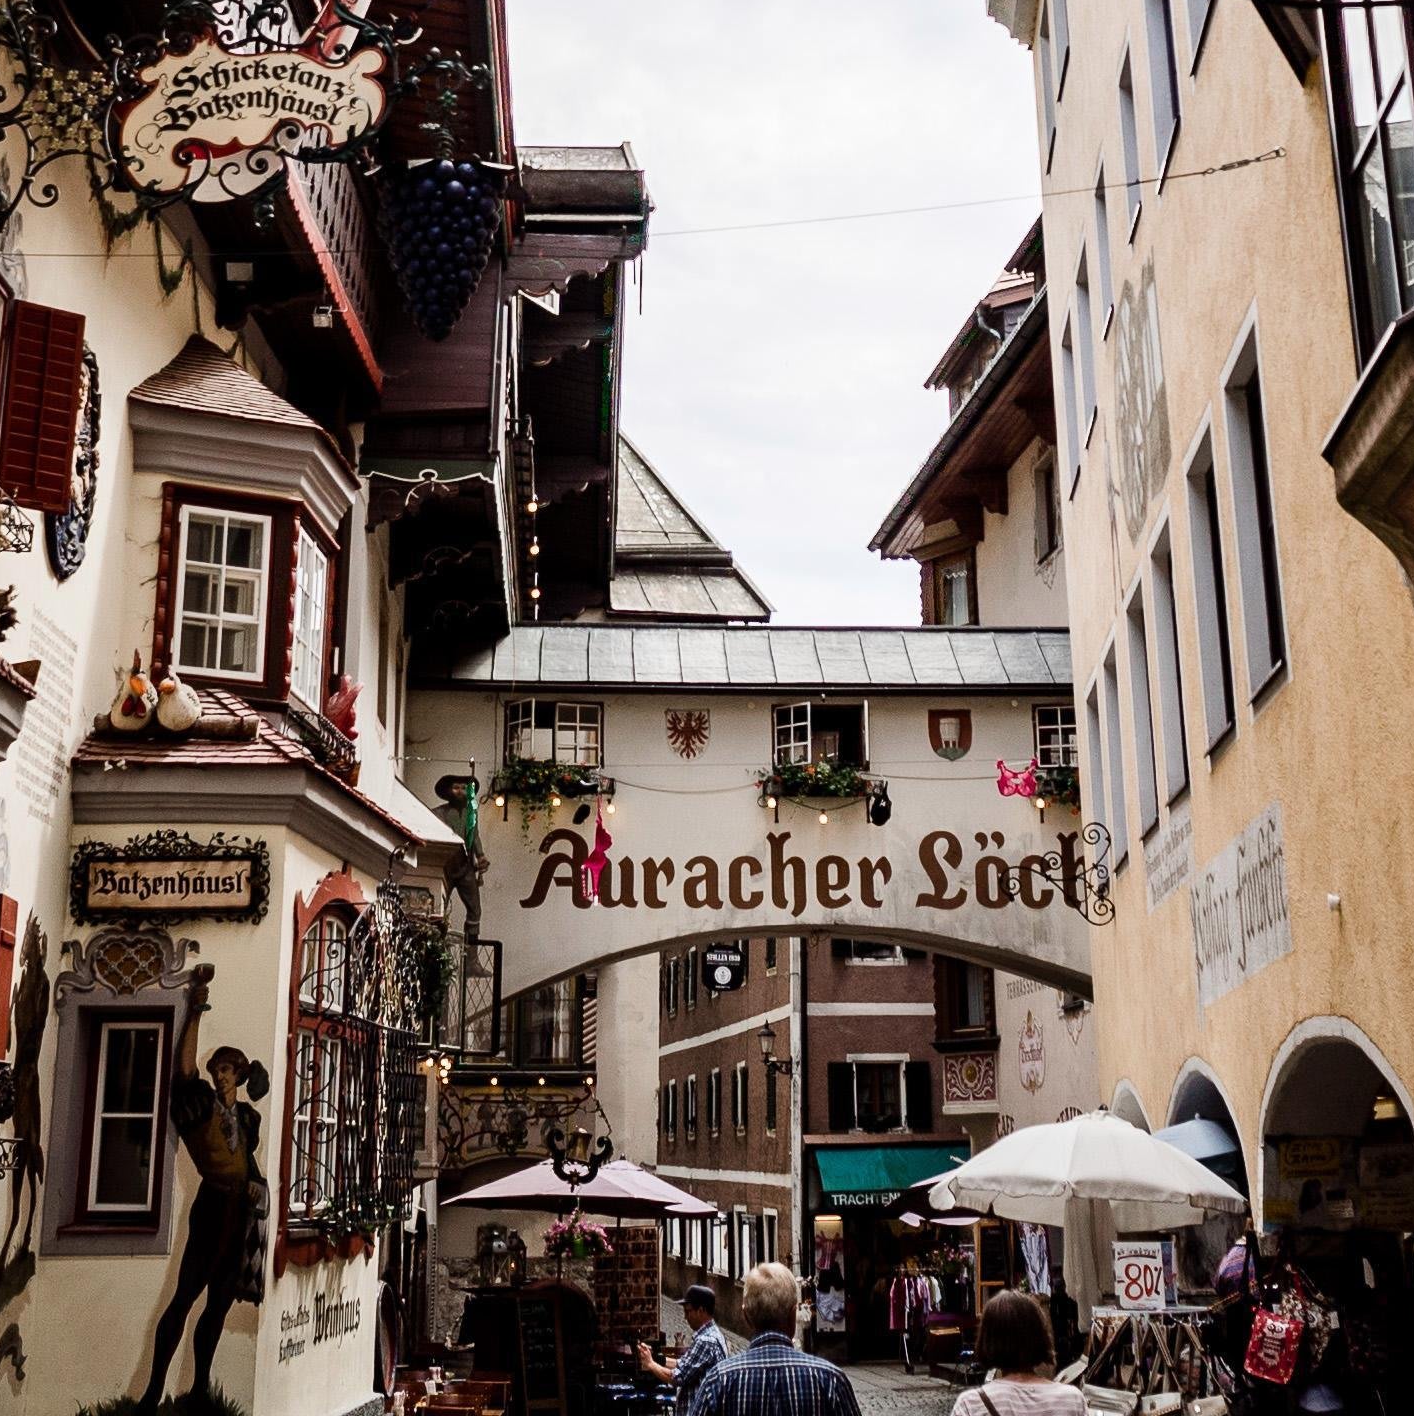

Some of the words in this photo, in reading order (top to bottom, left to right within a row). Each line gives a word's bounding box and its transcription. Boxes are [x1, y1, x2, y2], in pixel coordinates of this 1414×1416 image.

[168, 57, 350, 101] Schicketanz
[154, 87, 347, 130] Batzenhäusl
[93, 868, 248, 899] Batzenhäusl
[519, 828, 891, 917] Auracher
[916, 829, 1086, 911] Löch
[313, 1287, 361, 1348] Weinhaus
